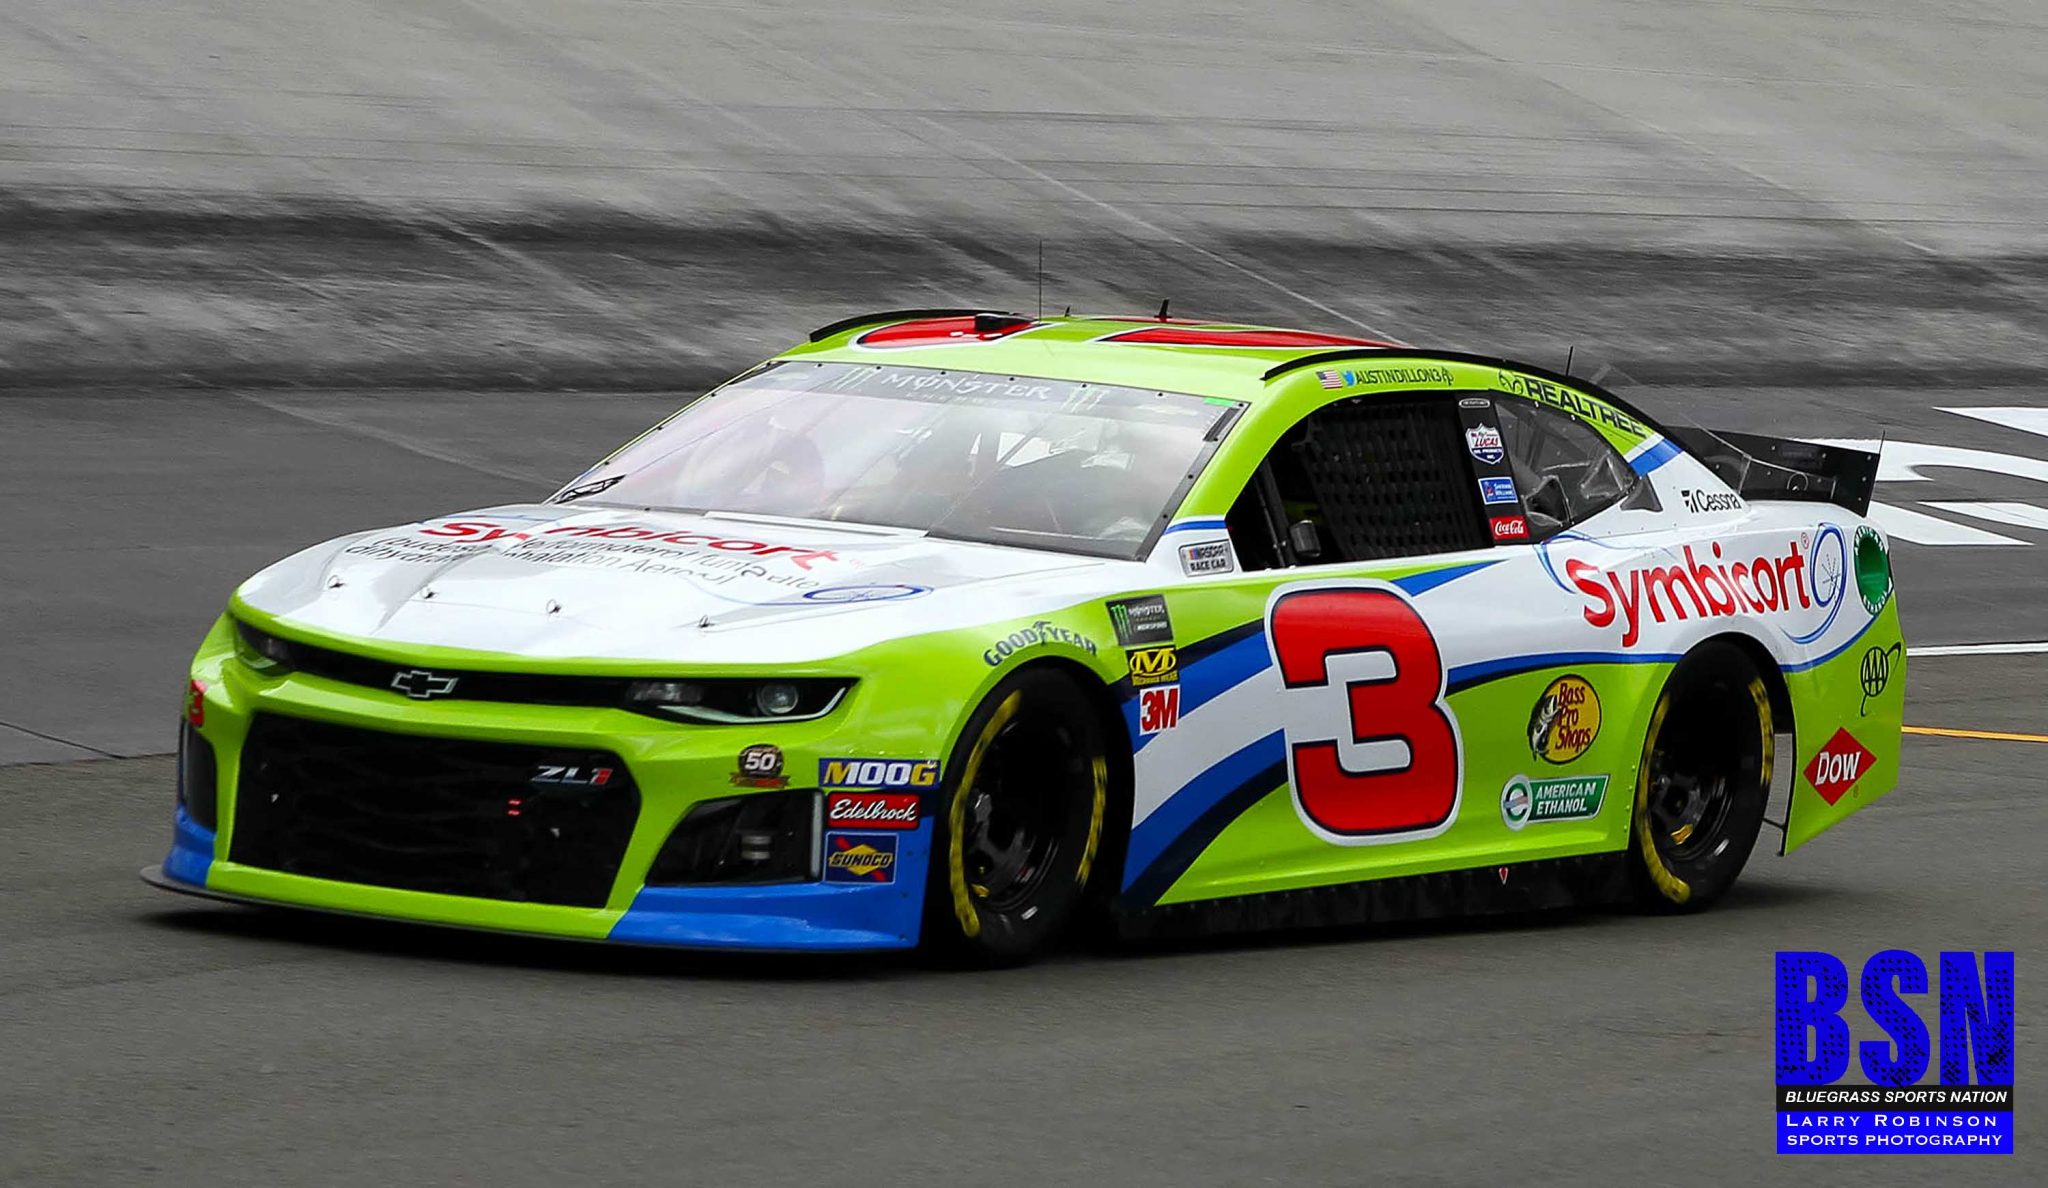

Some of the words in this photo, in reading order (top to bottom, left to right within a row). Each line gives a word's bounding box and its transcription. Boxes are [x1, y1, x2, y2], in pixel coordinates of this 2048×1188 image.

[1524, 376, 1649, 440] REALTREE
[1696, 489, 1743, 512] Cessna
[1190, 560, 1210, 572] RACE
[1211, 558, 1226, 569] CAR
[1565, 541, 1812, 648] Symbicort
[1557, 682, 1586, 706] Bass
[1141, 688, 1179, 731] 3M
[1266, 580, 1463, 844] 3
[1558, 705, 1580, 728] Pro
[1555, 726, 1592, 753] Shops
[744, 752, 776, 770] 50
[531, 765, 614, 785] ZL1
[823, 761, 937, 786] MOOG
[1535, 781, 1597, 801] AMERICAN
[829, 798, 917, 821] Edelbrock
[1535, 797, 1588, 816] ETHANOL
[831, 852, 891, 868] SUNOCO
